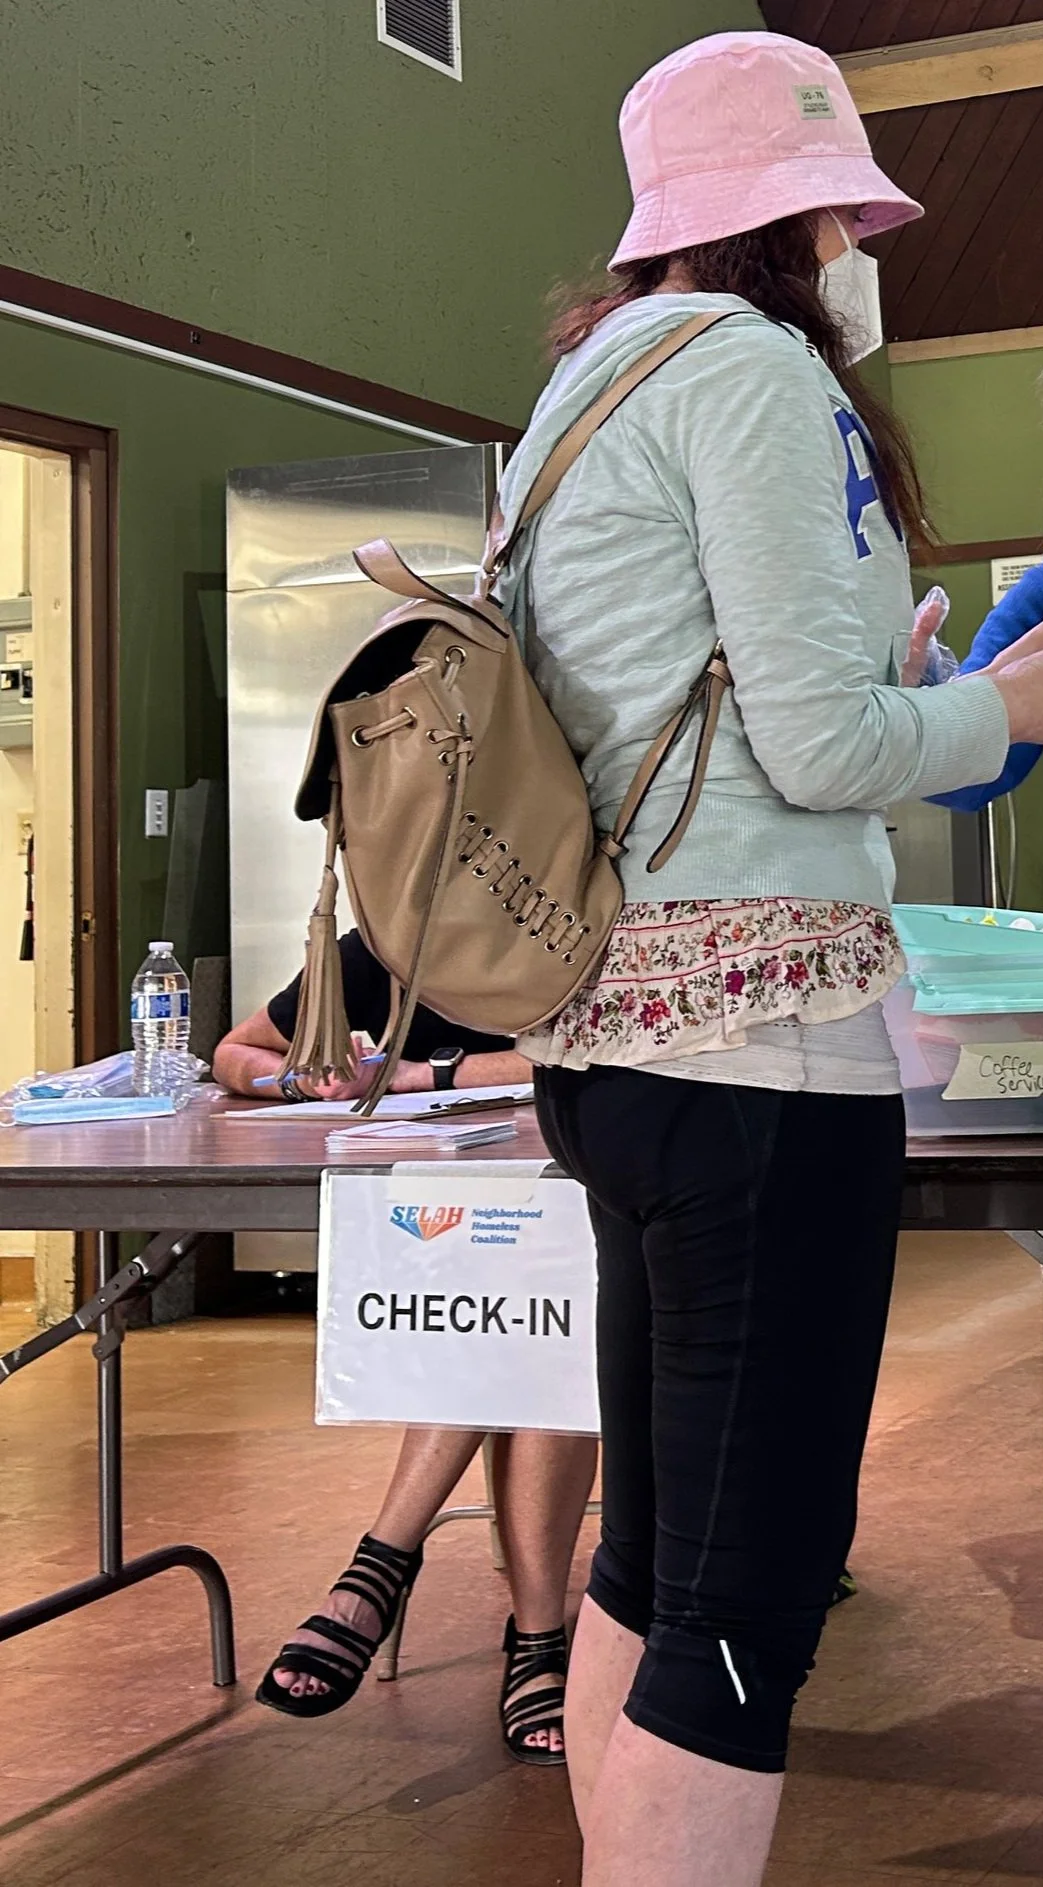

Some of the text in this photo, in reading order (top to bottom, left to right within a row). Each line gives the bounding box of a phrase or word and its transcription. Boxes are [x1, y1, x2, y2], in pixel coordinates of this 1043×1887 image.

[979, 1055, 1034, 1078] Coffee
[390, 1205, 465, 1224] SELAH
[471, 1208, 544, 1220] Neighborhood
[471, 1221, 521, 1231] Homeless
[471, 1234, 517, 1245] Coalition
[357, 1292, 571, 1338] CHECK-IN
